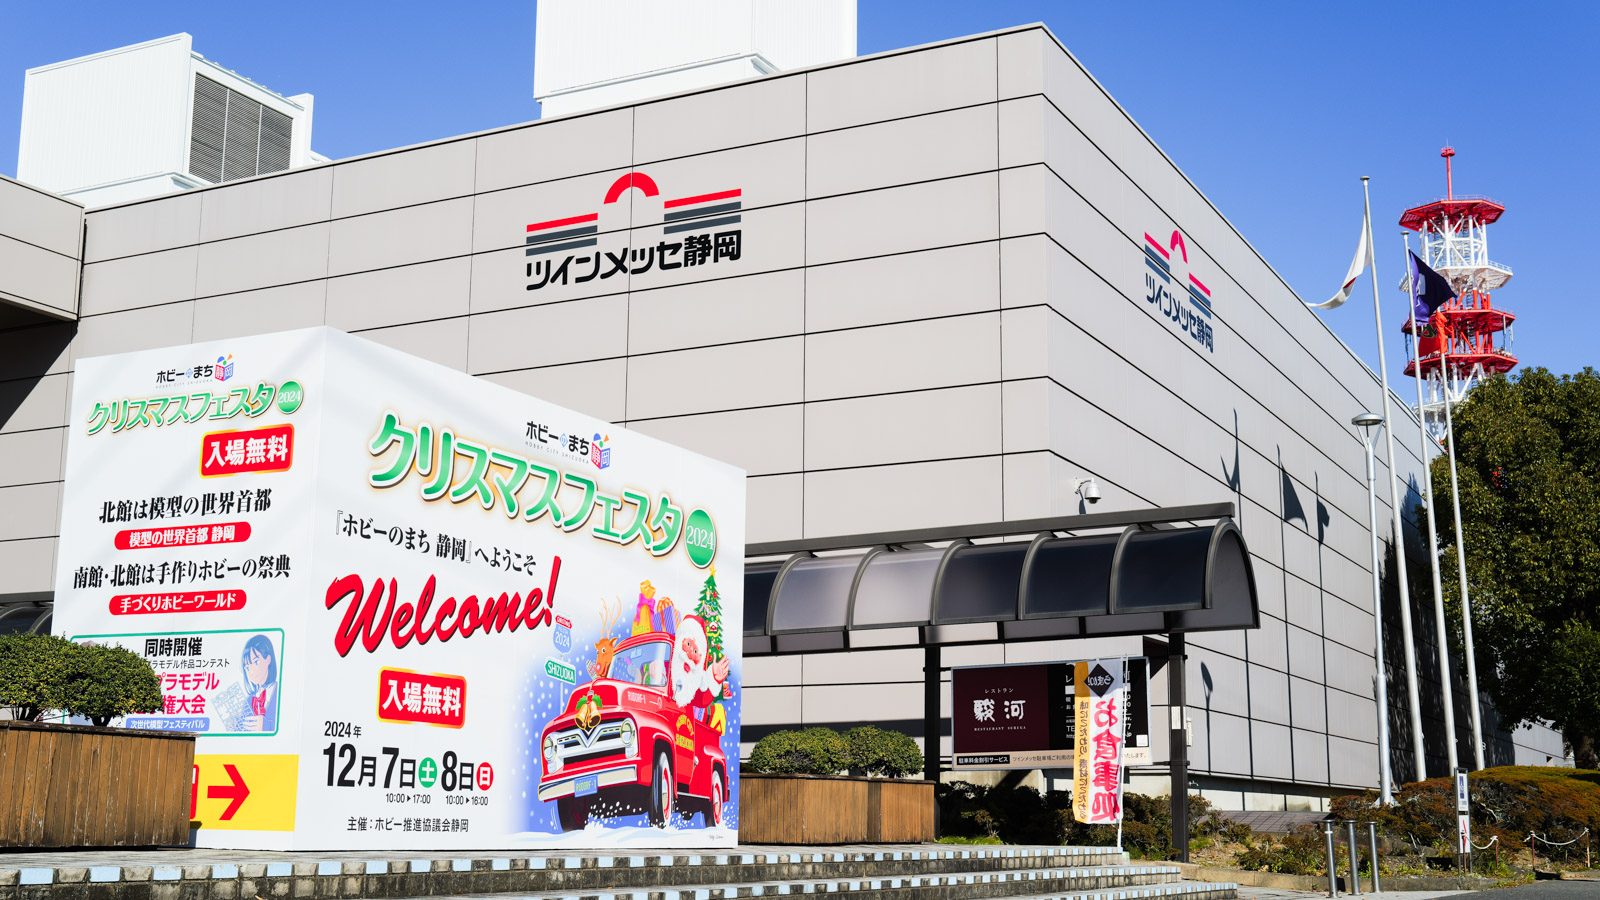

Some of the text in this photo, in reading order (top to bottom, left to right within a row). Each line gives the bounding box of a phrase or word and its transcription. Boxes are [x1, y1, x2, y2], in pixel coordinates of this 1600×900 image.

[526, 230, 742, 291] ツインメッセ静岡
[1145, 272, 1214, 354] ツインメッセ静岡
[88, 383, 302, 435] クリスマスフェスタ 2024
[205, 434, 288, 468] 入場無料
[369, 410, 685, 556] クリスマスフェスタ
[99, 487, 272, 524] 北館は模型の世界首都
[129, 525, 236, 548] 模型の世界首都 静岡
[686, 525, 716, 551] 2024
[73, 554, 292, 589] 南館・北館は手作りホビーの祭典
[120, 592, 237, 614] 手づくりホビーワールド
[325, 555, 562, 658] Welcome!
[144, 636, 203, 657] 同時開催
[555, 631, 570, 648] 2024
[547, 661, 575, 682] SHIZUOKA
[382, 678, 462, 717] 入場無料
[973, 698, 1027, 723] 駿河
[130, 718, 206, 730] 次世代模型フェスティバル
[324, 720, 362, 738] 2024年
[958, 756, 1009, 764] 駐車料金割引サービス
[386, 793, 431, 805] 10:00 17:00
[445, 795, 489, 806] 10:00 16:00
